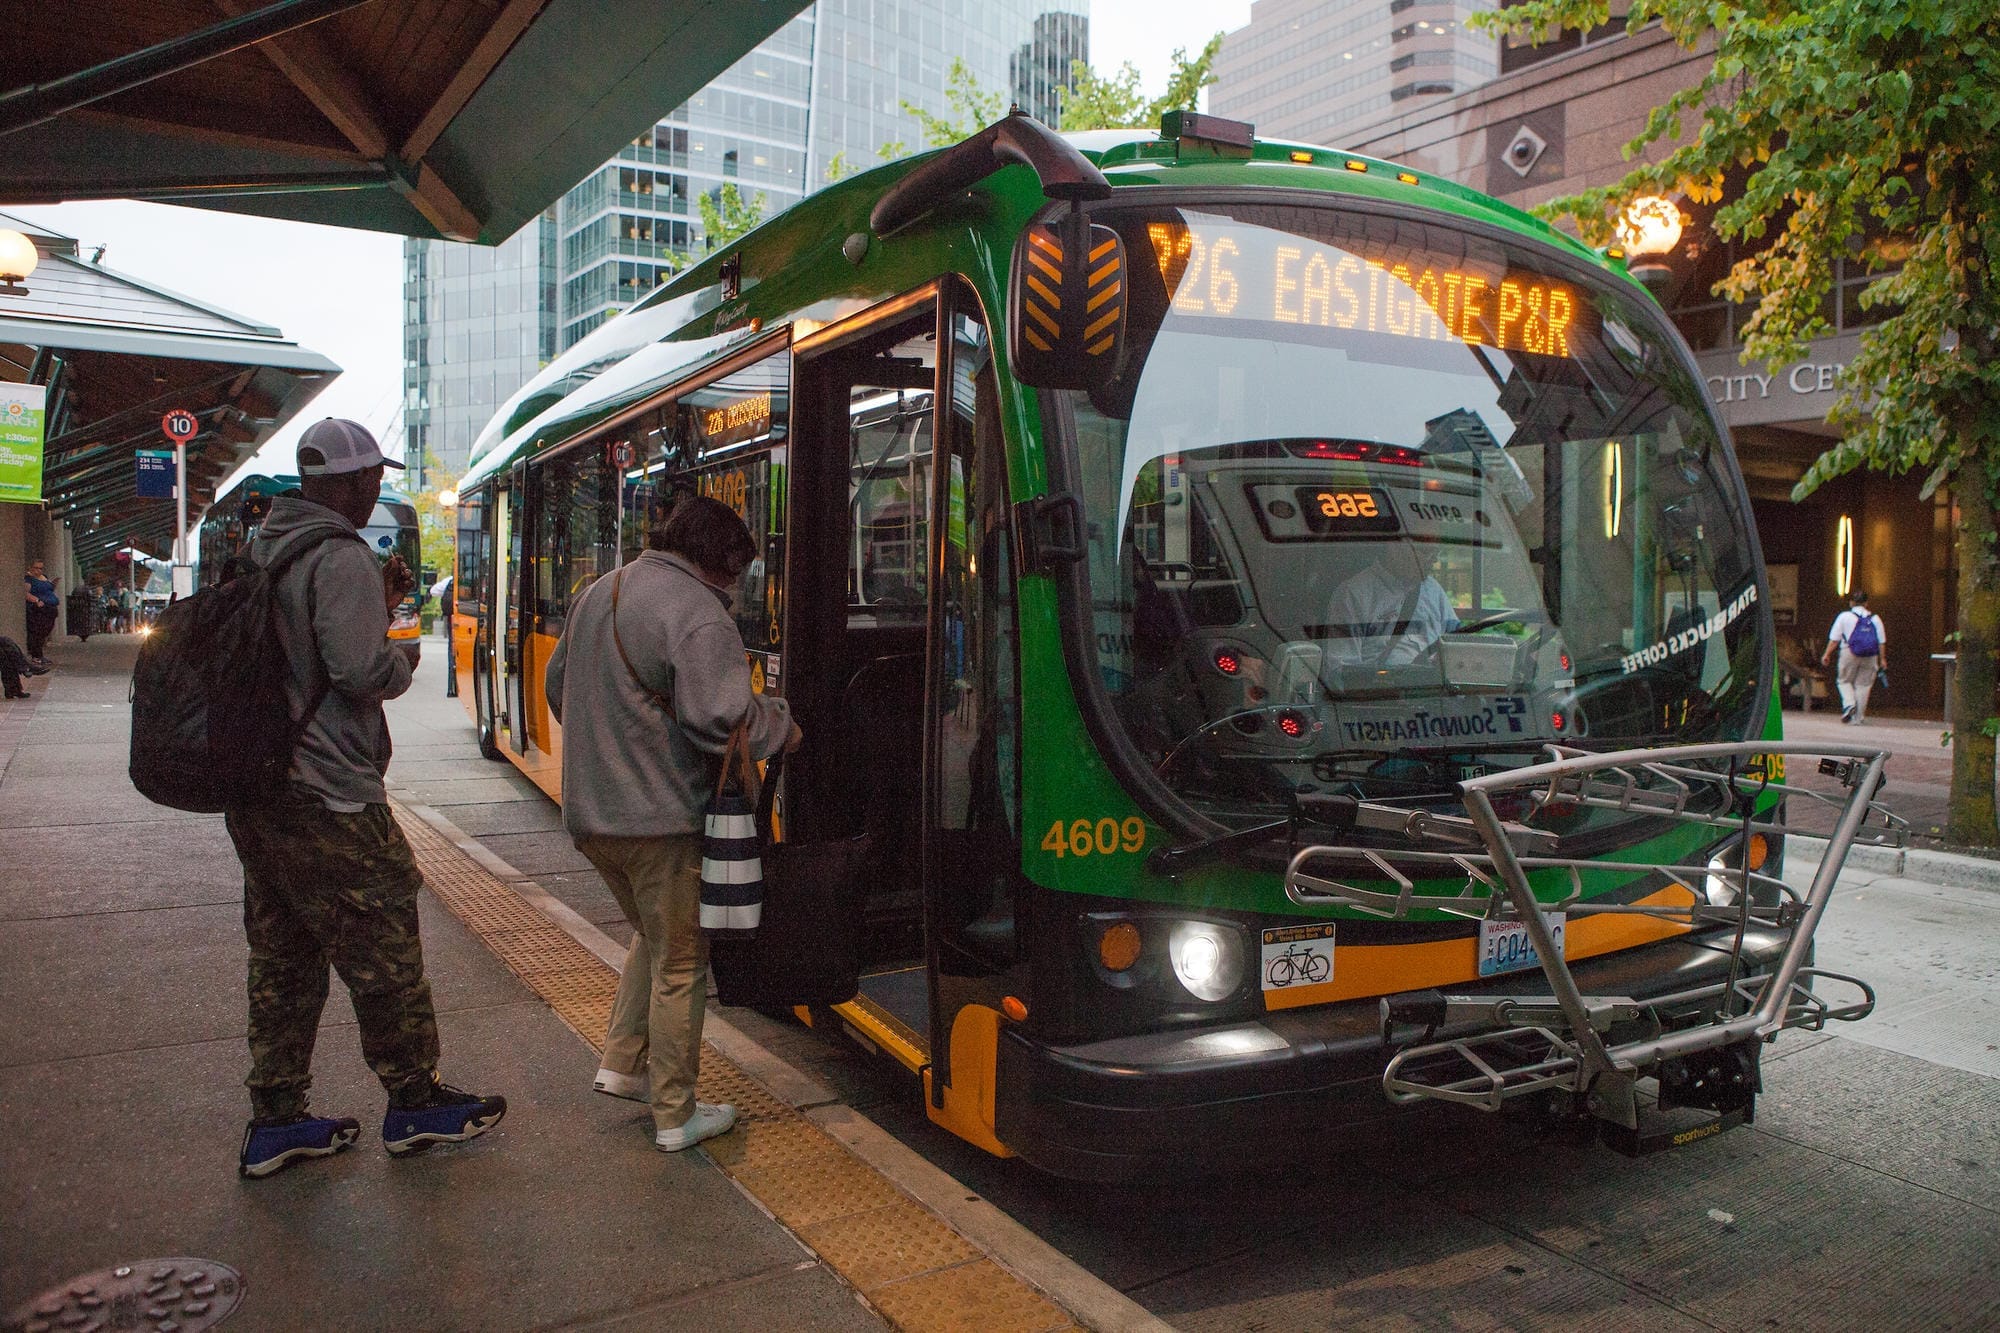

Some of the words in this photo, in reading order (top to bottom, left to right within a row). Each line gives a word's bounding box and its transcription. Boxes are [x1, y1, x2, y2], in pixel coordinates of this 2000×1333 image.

[1275, 246, 1485, 345] EASTGATE
[1498, 281, 1571, 357] P&R
[171, 418, 191, 433] 10
[707, 411, 724, 436] 226
[1041, 816, 1146, 859] 4609
[1673, 1123, 1720, 1145] sportworks
